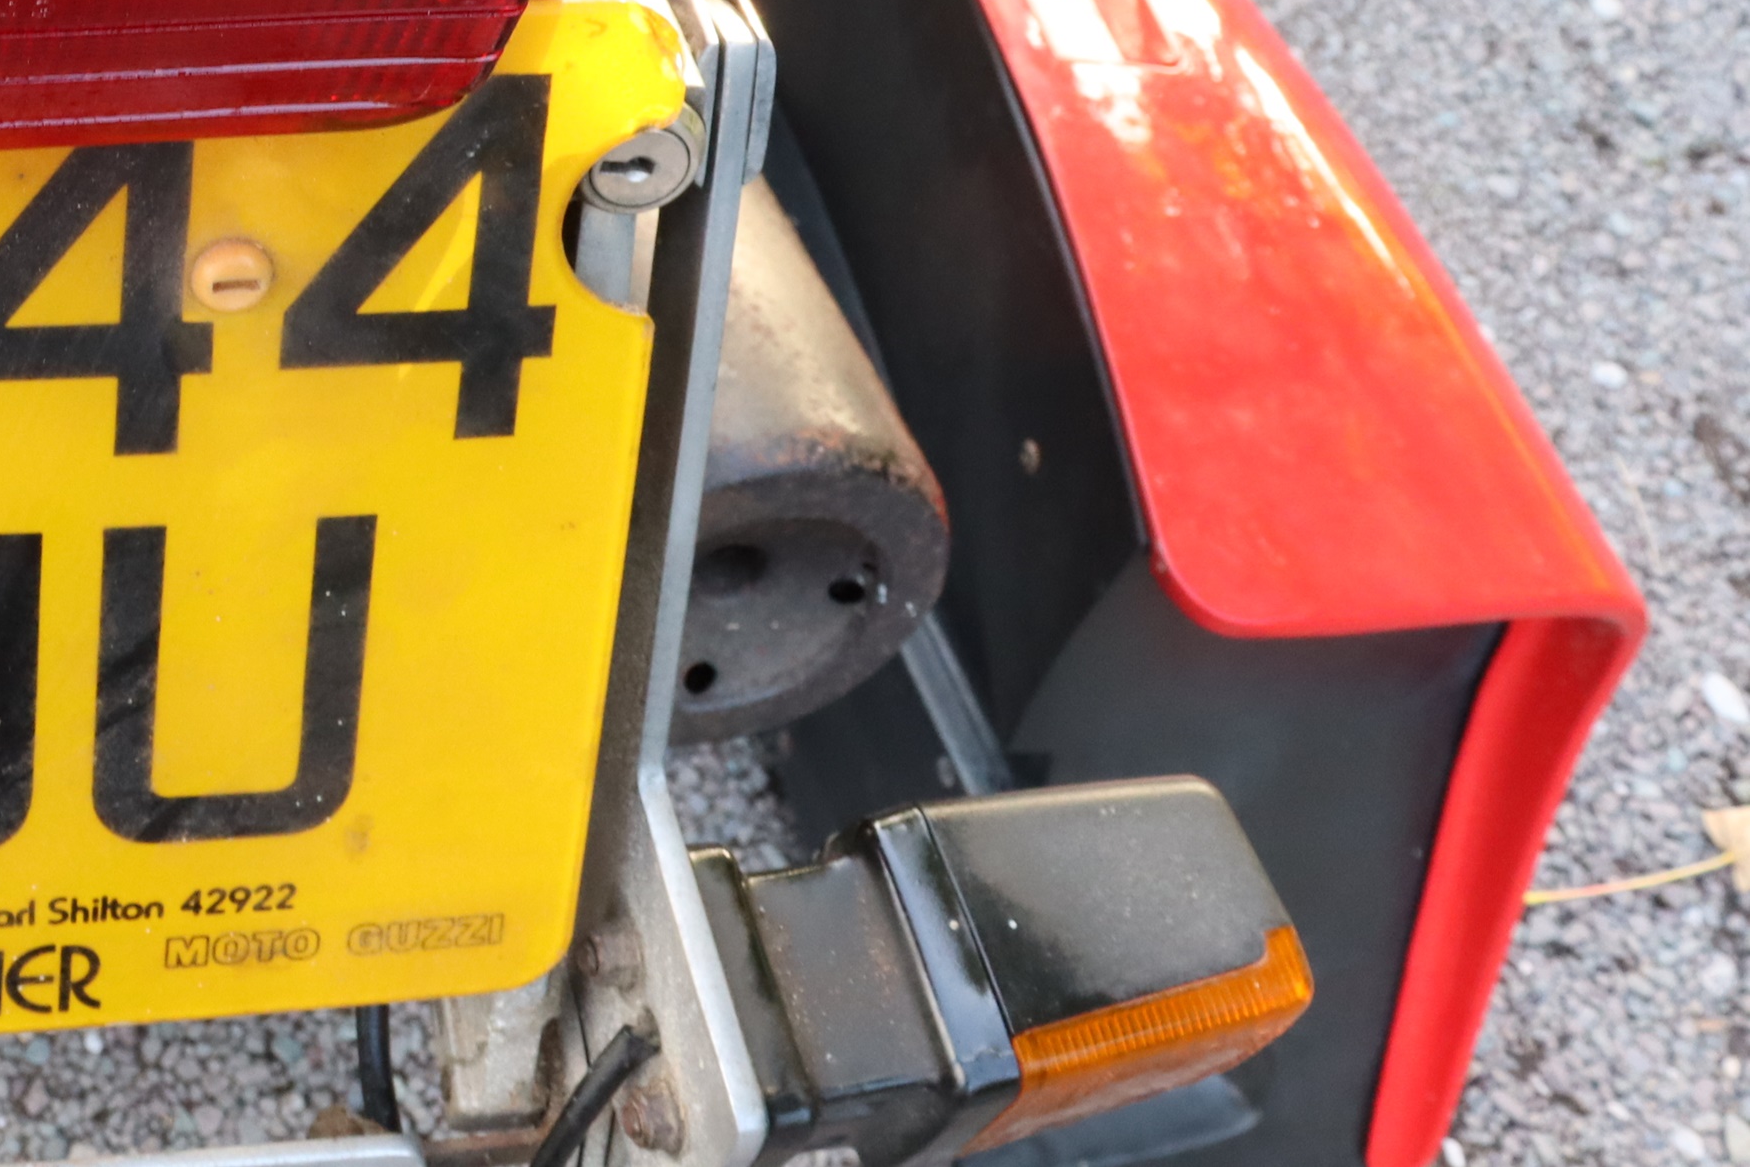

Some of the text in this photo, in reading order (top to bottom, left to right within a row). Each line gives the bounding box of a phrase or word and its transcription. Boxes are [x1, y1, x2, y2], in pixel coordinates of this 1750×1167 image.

[48, 894, 165, 926] Shilton
[180, 883, 297, 916] 42922
[164, 913, 505, 969] MOTO GUZZI
